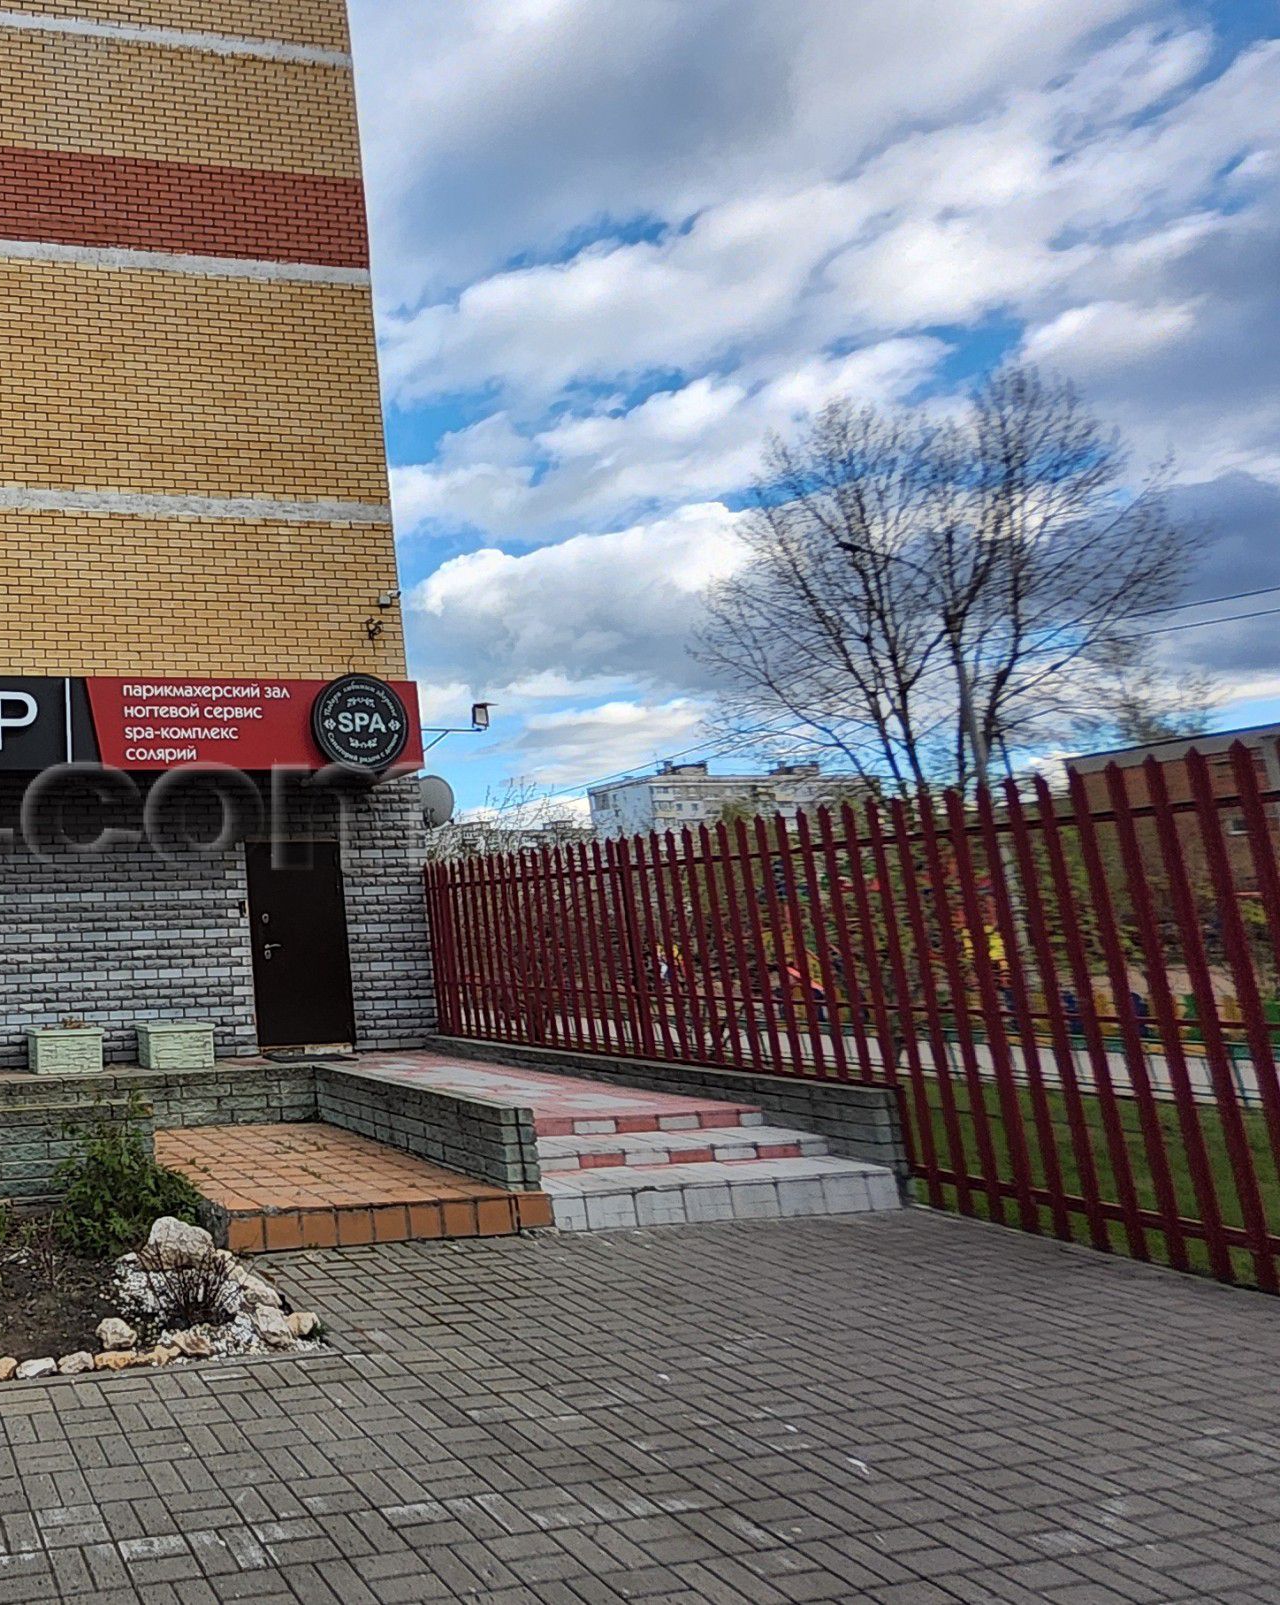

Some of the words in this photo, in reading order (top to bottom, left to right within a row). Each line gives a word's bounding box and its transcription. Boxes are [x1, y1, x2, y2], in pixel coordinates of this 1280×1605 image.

[122, 683, 261, 700] парикмахерский
[264, 686, 291, 699] зал
[124, 703, 200, 718] ногтевой
[203, 706, 263, 721] сервис
[337, 711, 388, 734] SPA
[124, 726, 239, 742] spa-комплекс
[125, 745, 197, 763] солярий
